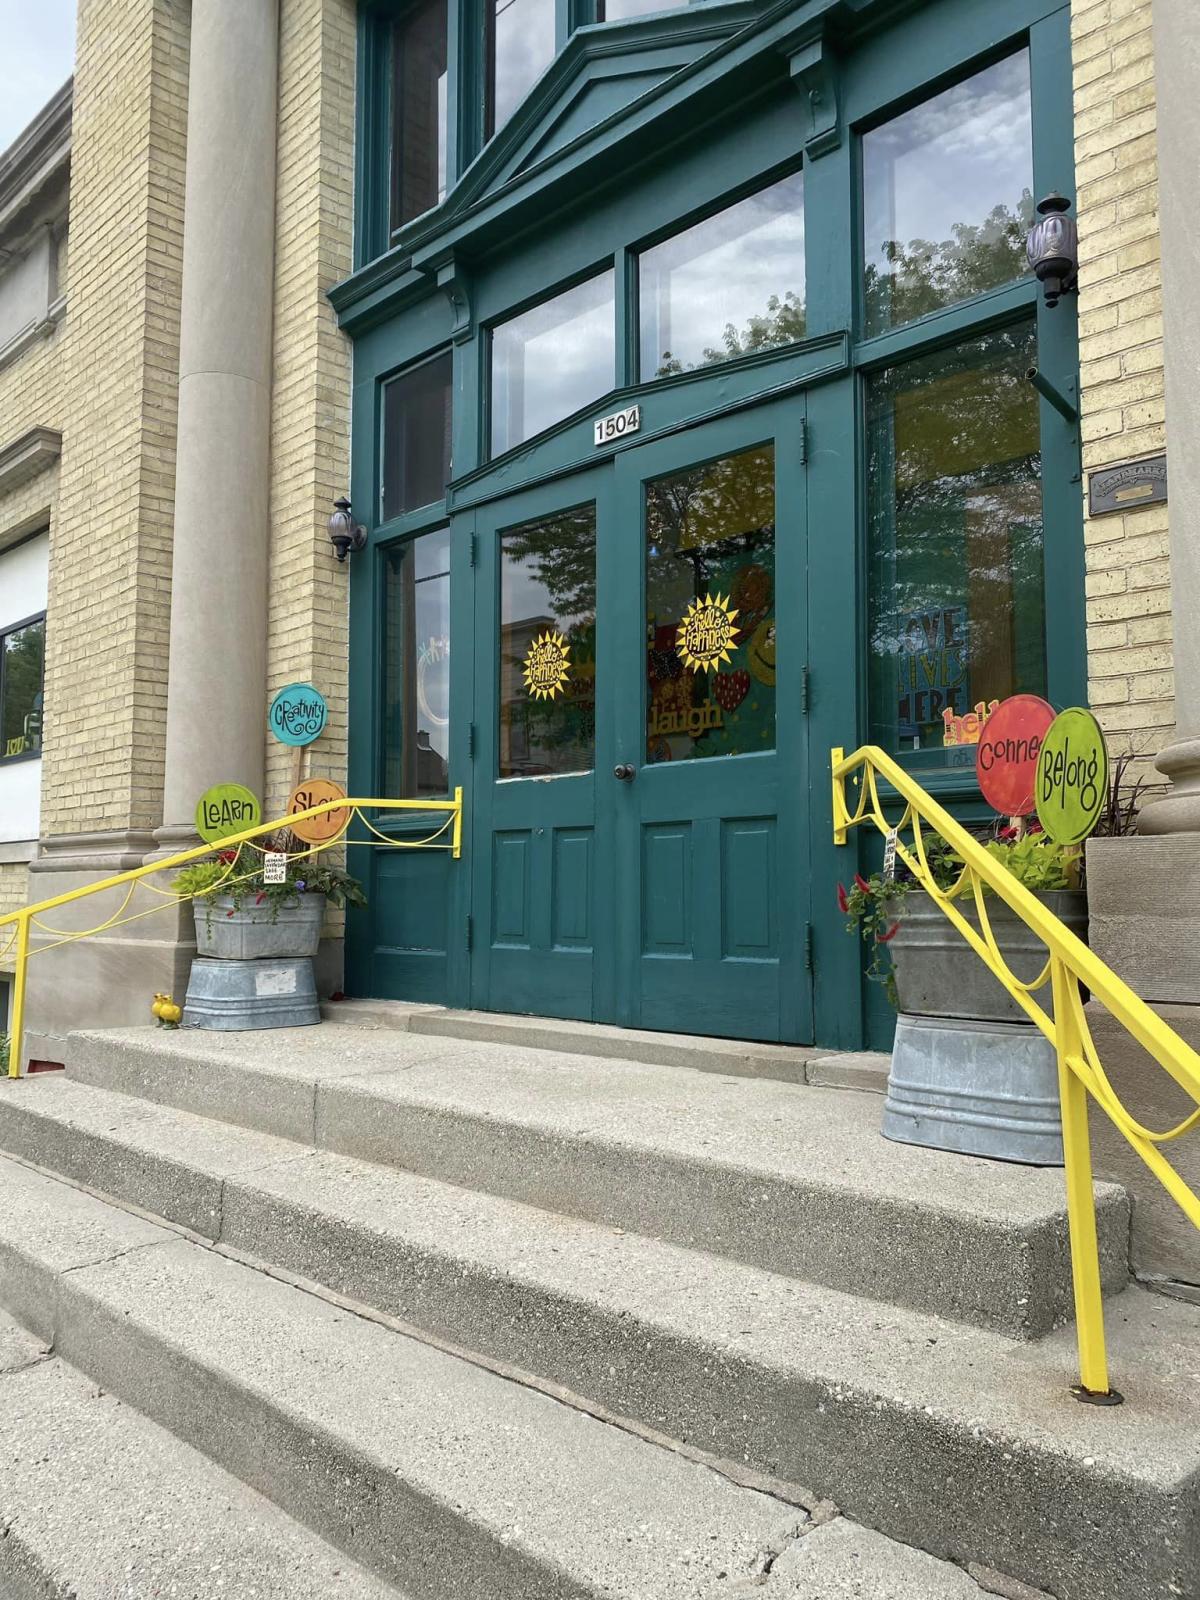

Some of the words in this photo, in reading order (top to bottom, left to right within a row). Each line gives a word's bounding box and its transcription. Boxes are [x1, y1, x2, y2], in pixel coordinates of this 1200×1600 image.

[596, 409, 638, 440] 1504
[688, 608, 725, 632] hello
[533, 643, 559, 663] hello
[651, 698, 723, 737] laugh
[942, 699, 999, 746] hel
[980, 735, 1042, 771] Conne
[1043, 736, 1098, 812] Belong
[264, 873, 283, 881] MORE
